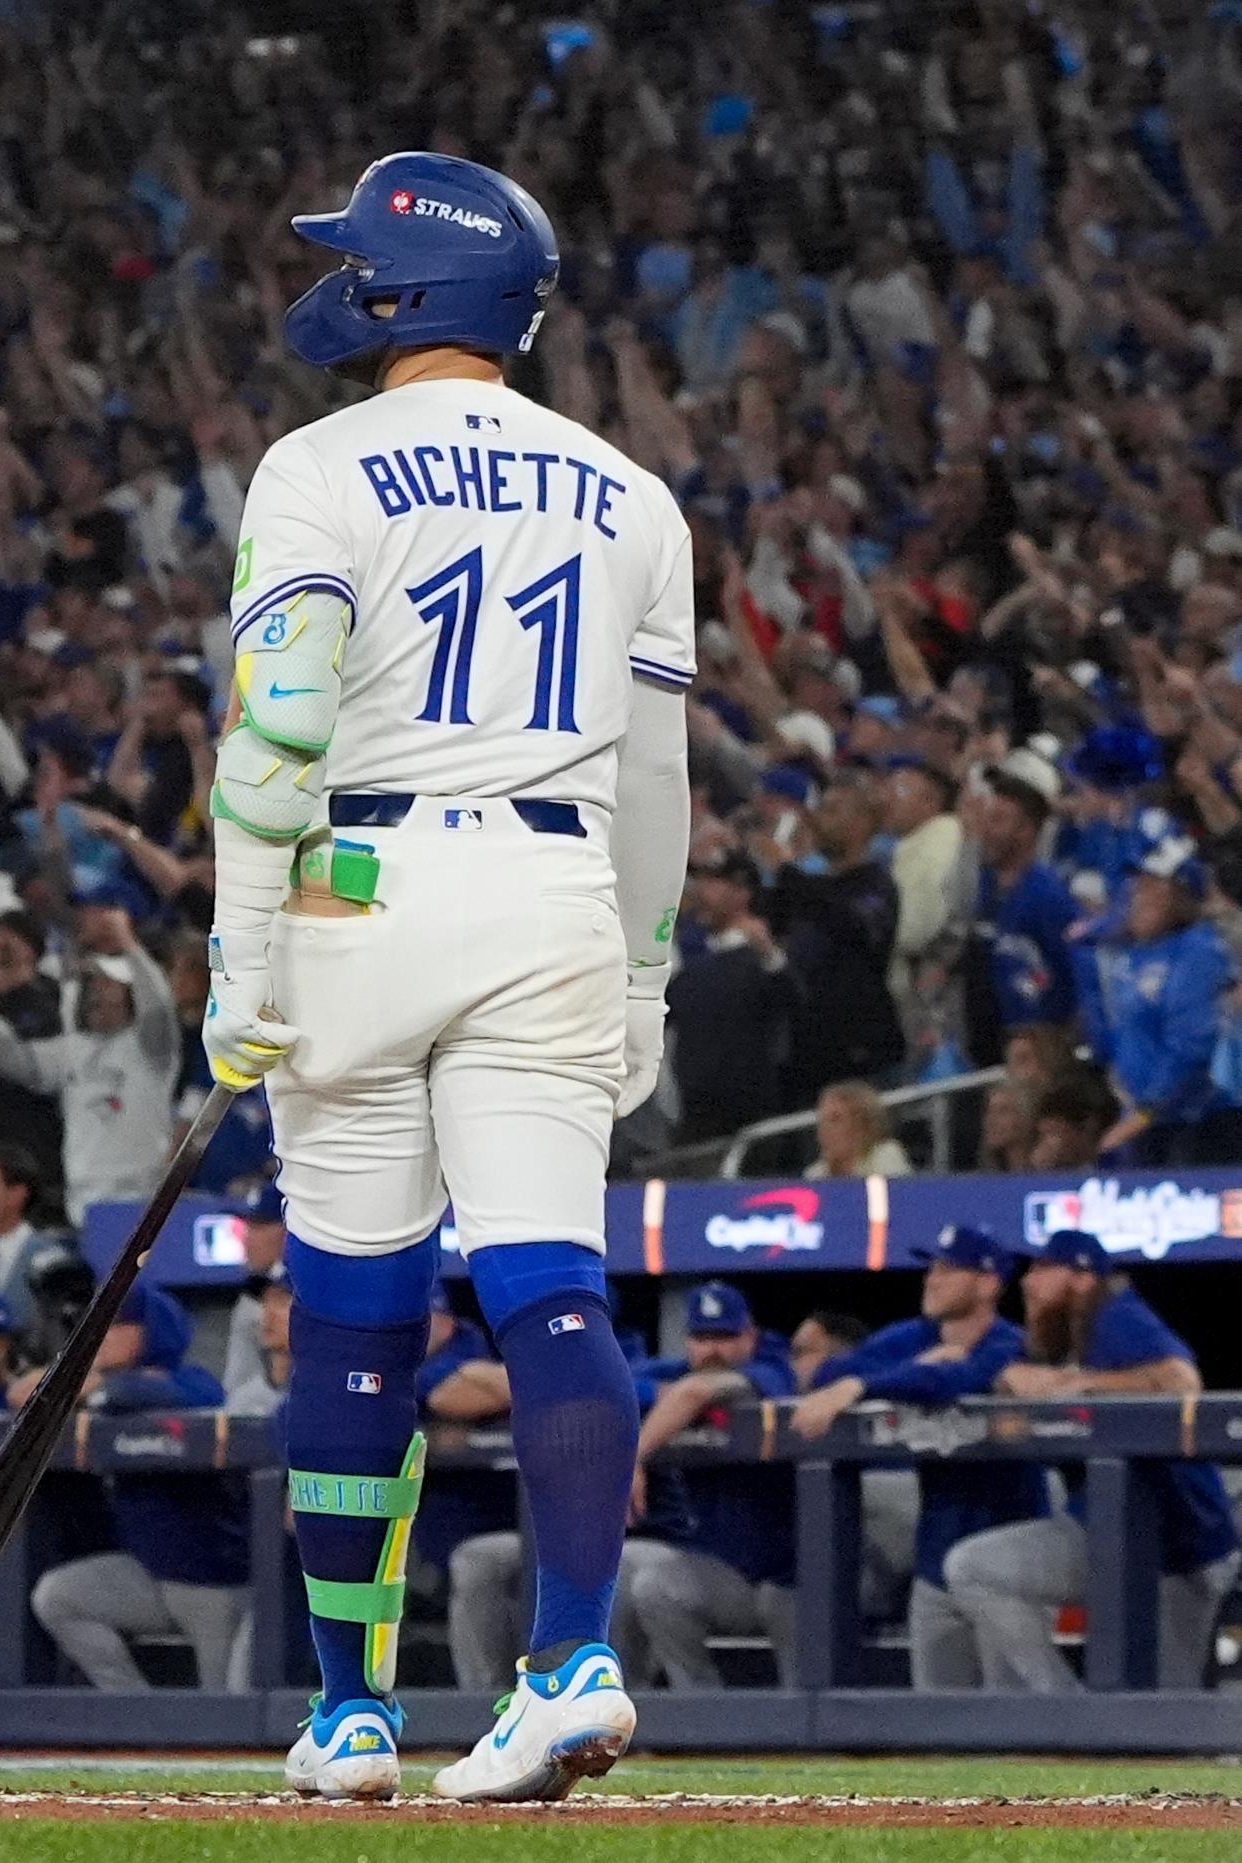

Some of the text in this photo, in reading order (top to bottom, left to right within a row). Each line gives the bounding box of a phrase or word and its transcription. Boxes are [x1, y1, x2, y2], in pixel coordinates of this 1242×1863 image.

[414, 198, 503, 238] STRAUSS
[359, 445, 626, 541] BICHETTE
[405, 544, 582, 735] 11
